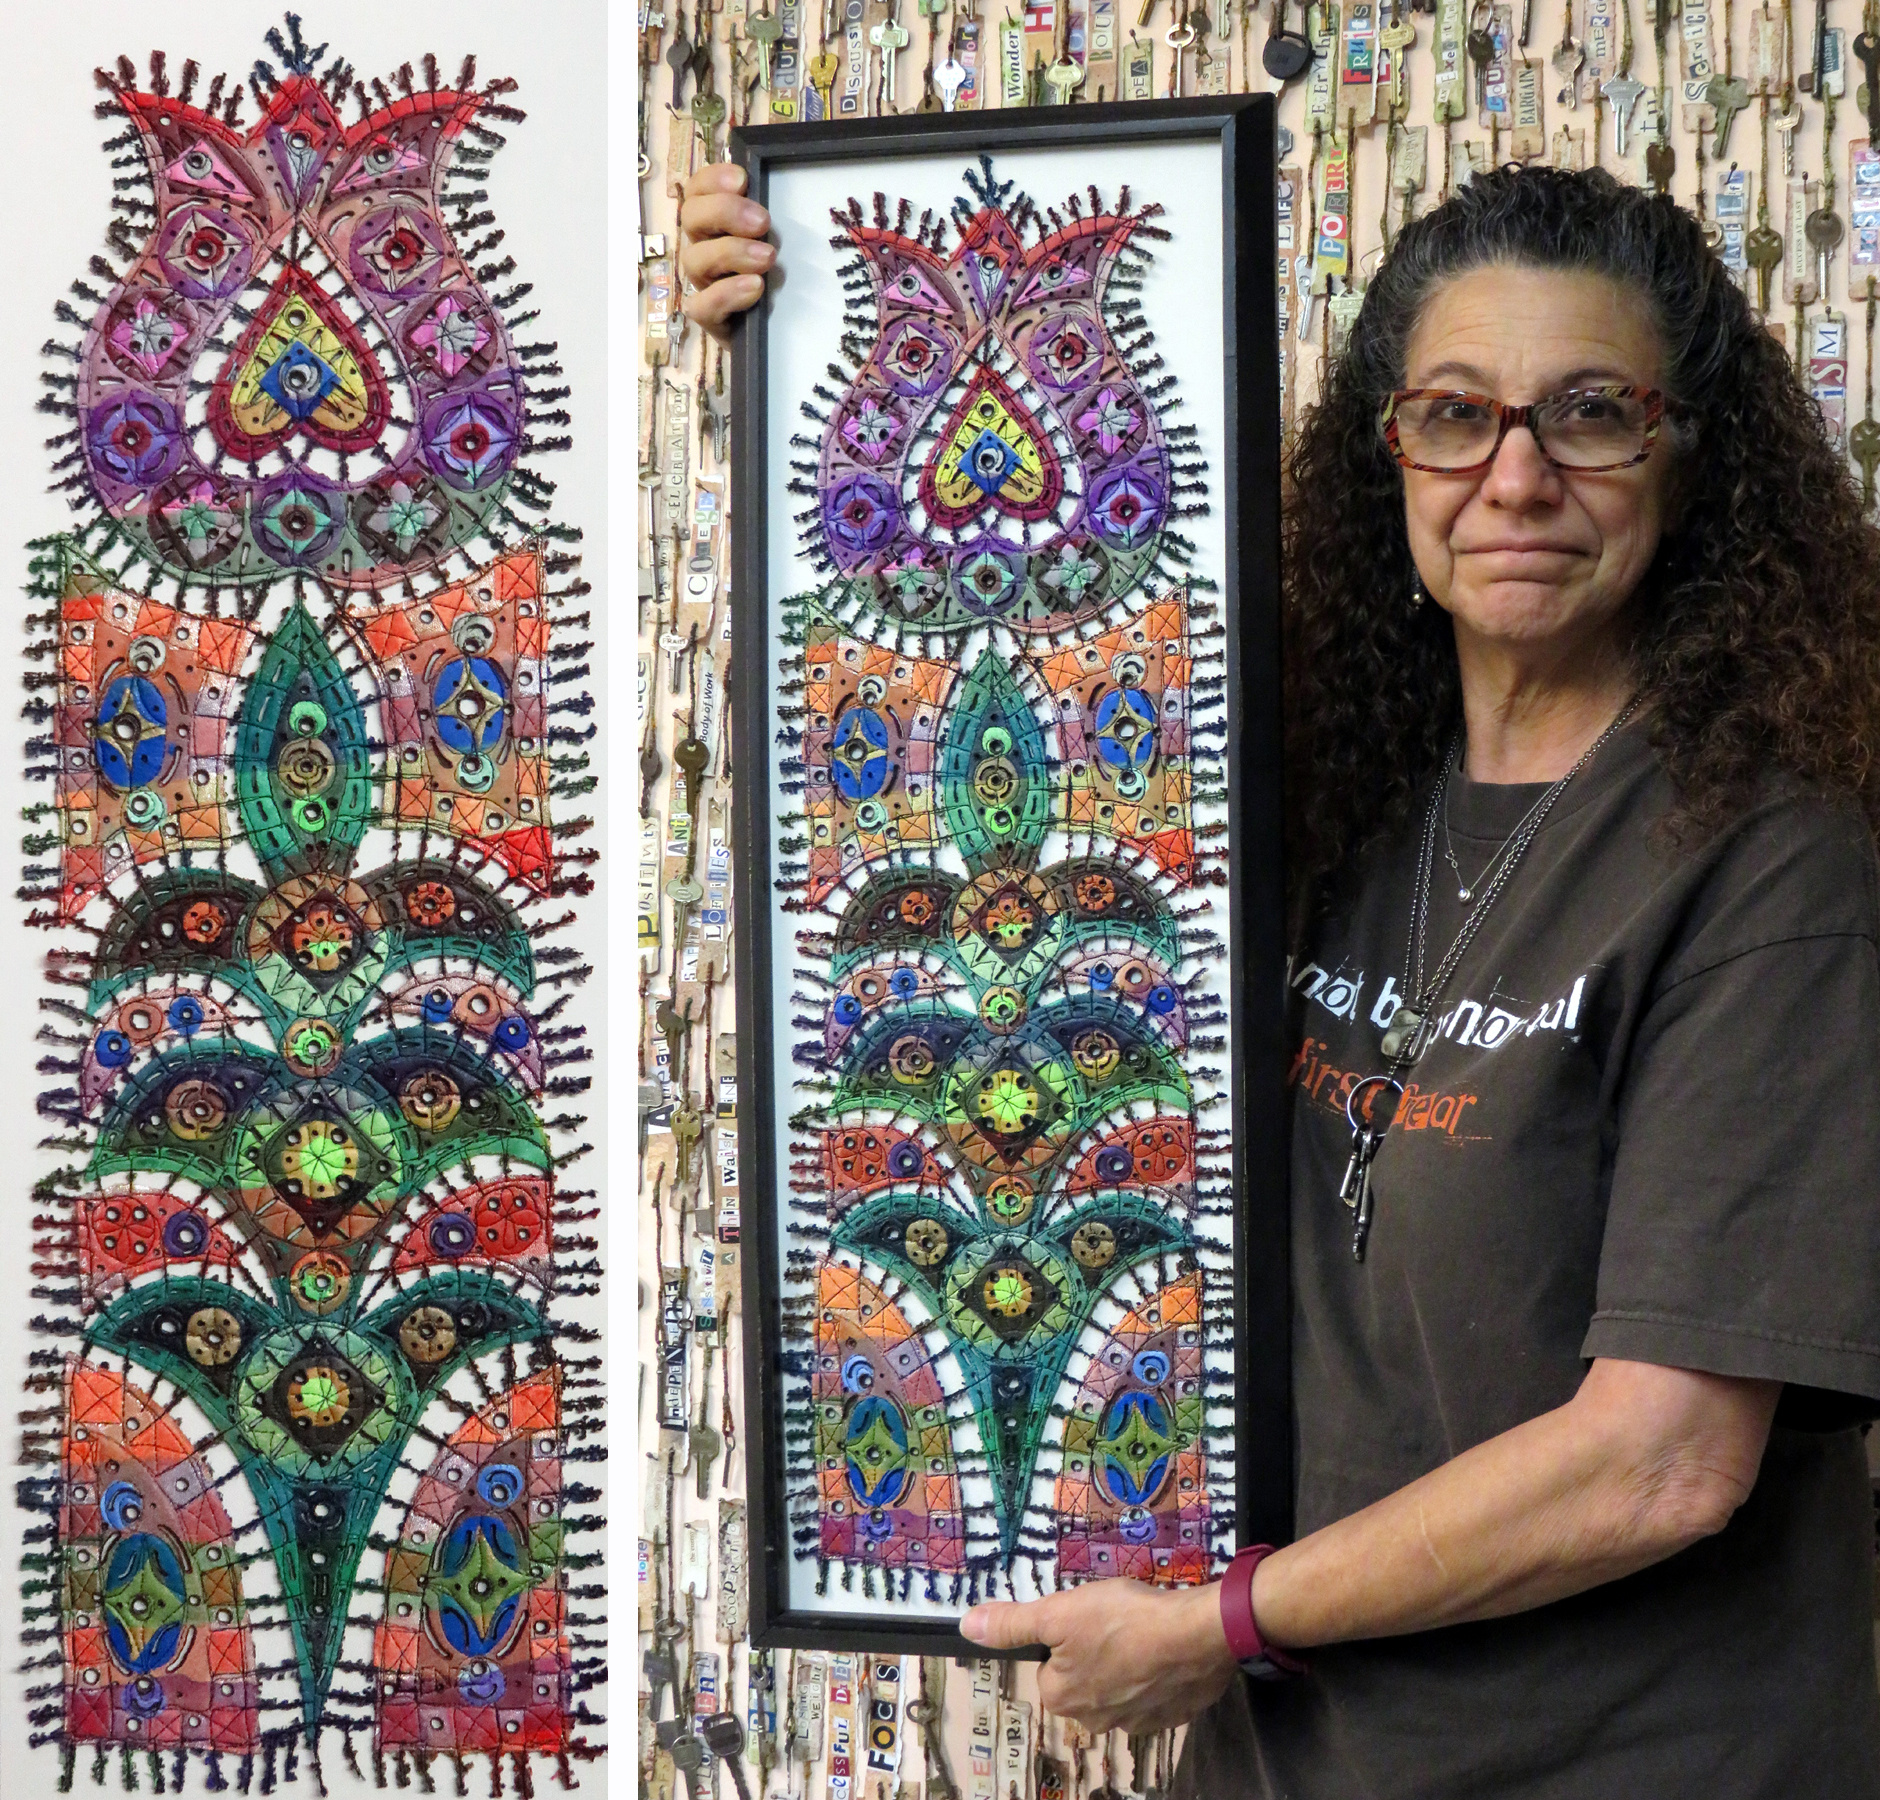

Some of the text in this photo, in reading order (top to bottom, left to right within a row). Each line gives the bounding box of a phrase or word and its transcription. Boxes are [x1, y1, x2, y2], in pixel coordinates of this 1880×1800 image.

[1007, 30, 1021, 99] Wonder
[1824, 35, 1838, 72] integrity
[1519, 69, 1536, 124] BARGAIN
[1795, 200, 1803, 220] LAST
[1796, 223, 1803, 235] AT
[699, 672, 714, 743] Body of Work
[1291, 963, 1364, 1026] not
[717, 1131, 736, 1184] Waist
[722, 1253, 735, 1264] A
[868, 1665, 900, 1772] FOCUS
